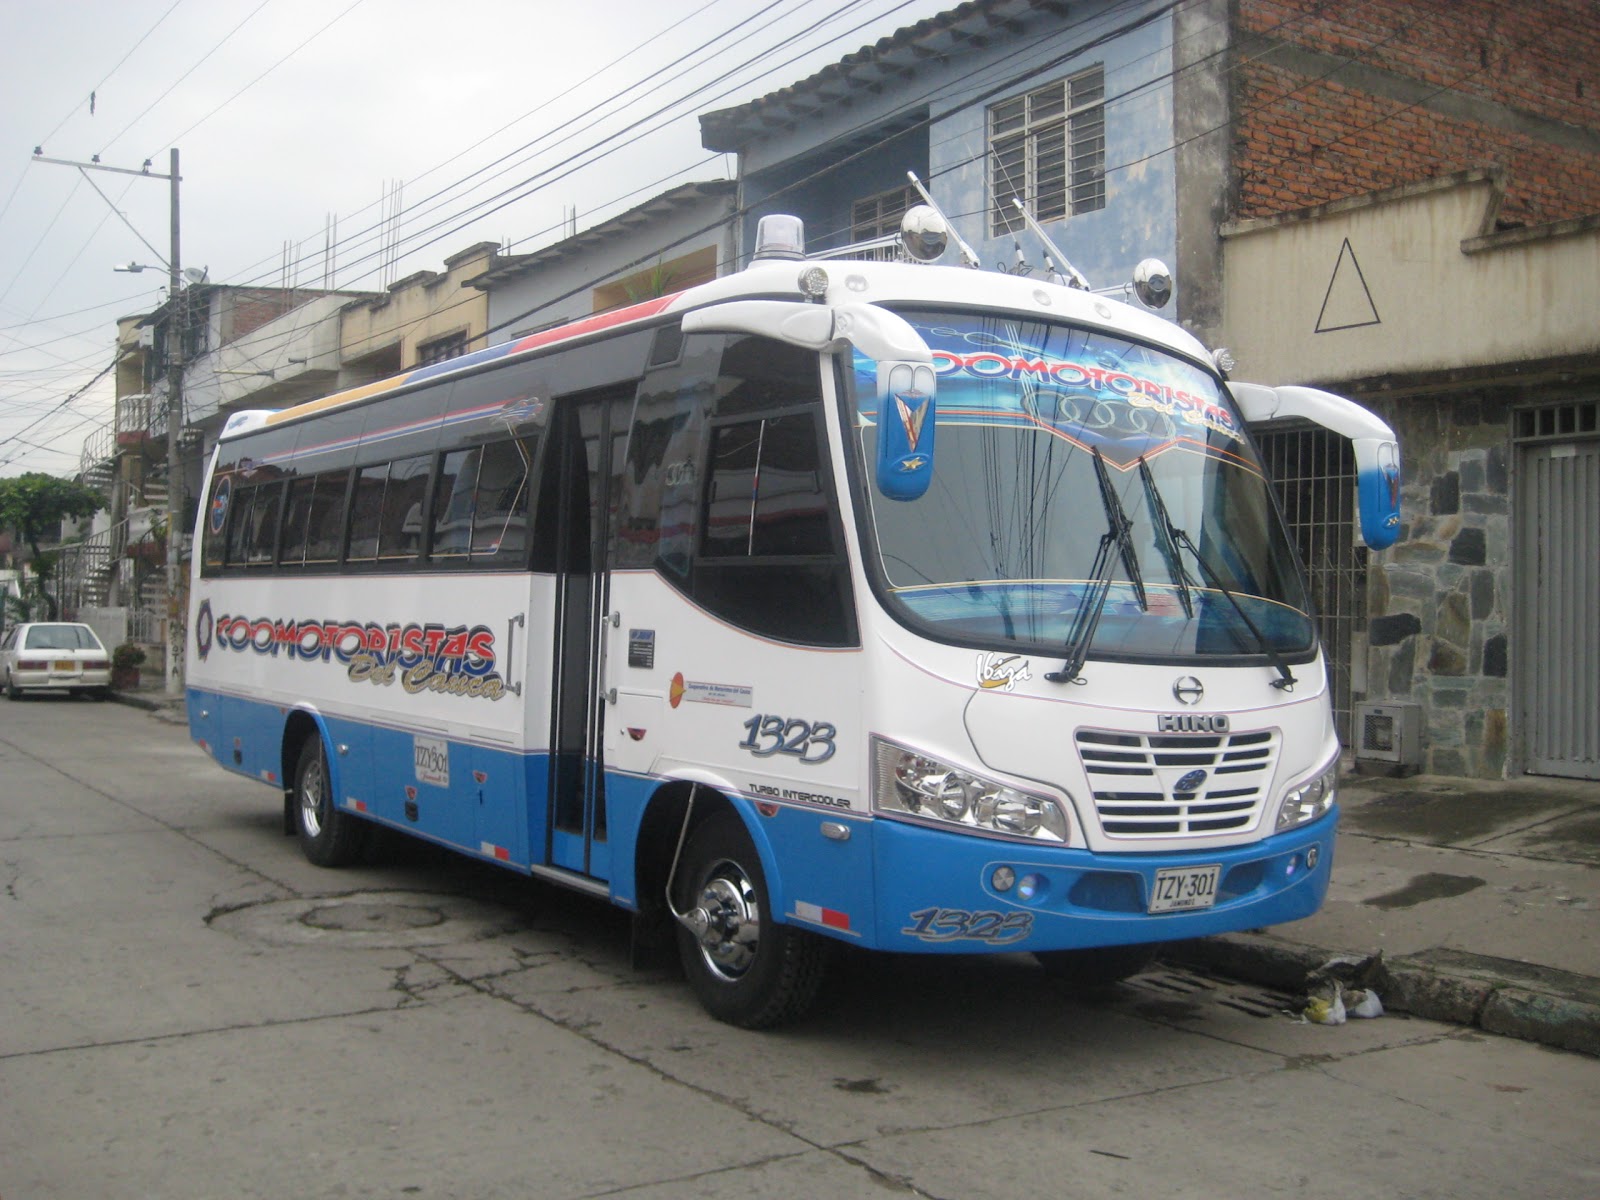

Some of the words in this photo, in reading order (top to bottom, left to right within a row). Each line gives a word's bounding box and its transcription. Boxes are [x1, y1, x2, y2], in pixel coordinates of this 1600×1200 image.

[931, 350, 1236, 431] OOMOTORISTAS
[216, 614, 495, 677] COOMOTORISTAS
[348, 653, 396, 686] Del
[402, 659, 507, 701] Cauca
[976, 652, 1033, 692] Ibiza
[739, 714, 836, 765] 1323
[1158, 714, 1230, 734] HINO
[749, 783, 780, 797] TURBO
[782, 788, 851, 809] INTERCOOLER
[901, 907, 1035, 945] 1323
